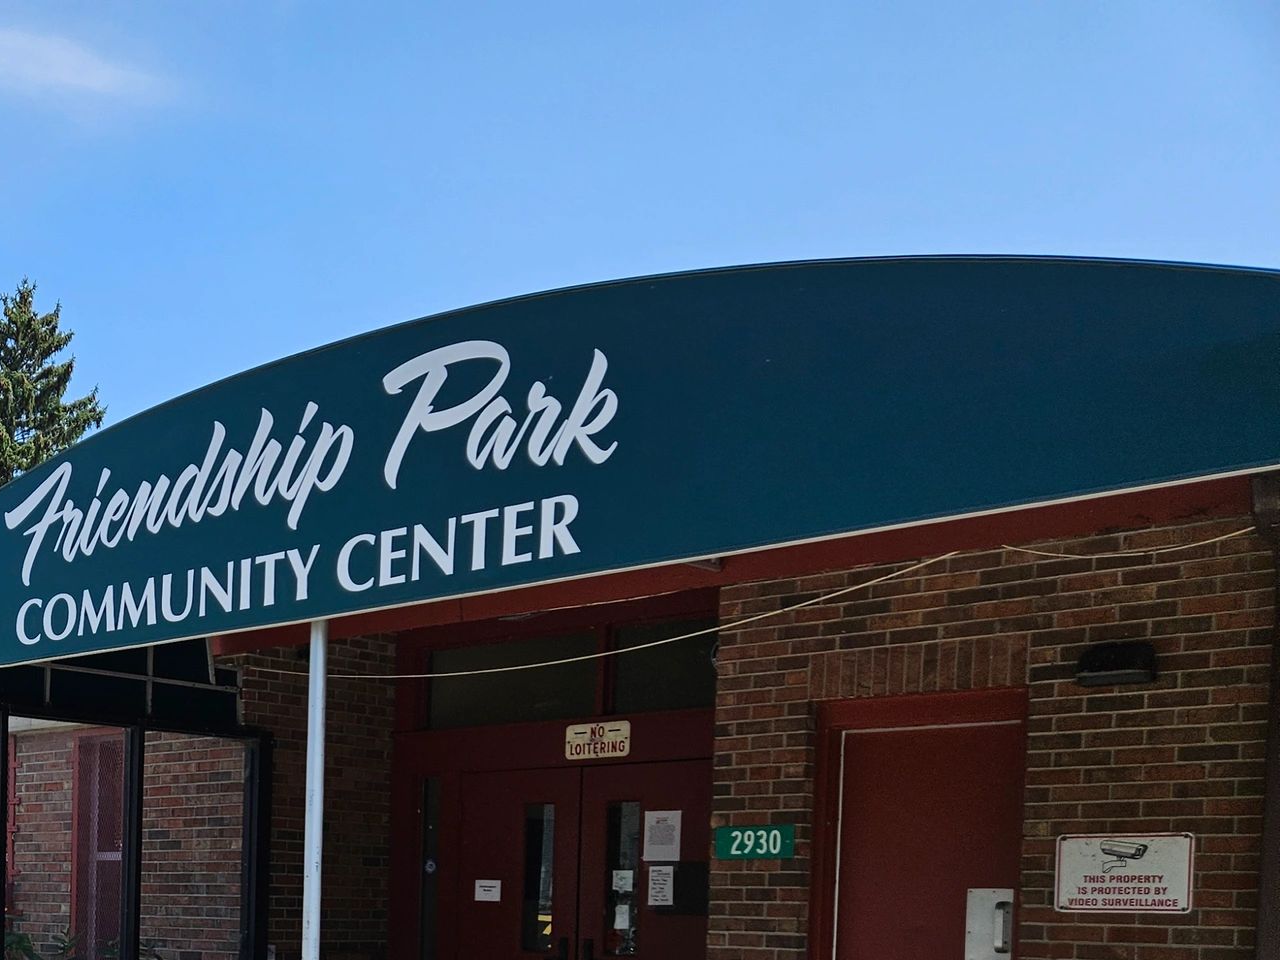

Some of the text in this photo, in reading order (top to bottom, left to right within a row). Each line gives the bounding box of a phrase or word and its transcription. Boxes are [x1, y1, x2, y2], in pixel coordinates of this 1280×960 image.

[5, 340, 618, 586] Friendship Park
[16, 494, 581, 646] COMMUNITY CENTER
[590, 726, 605, 738] NO
[569, 740, 625, 756] LOITERING
[730, 829, 782, 855] 2930
[1083, 875, 1164, 884] THIS PROPERTY
[1077, 887, 1168, 895] IS PROTECTED BY
[1068, 898, 1179, 908] VIDEO SURVEILLANCE
